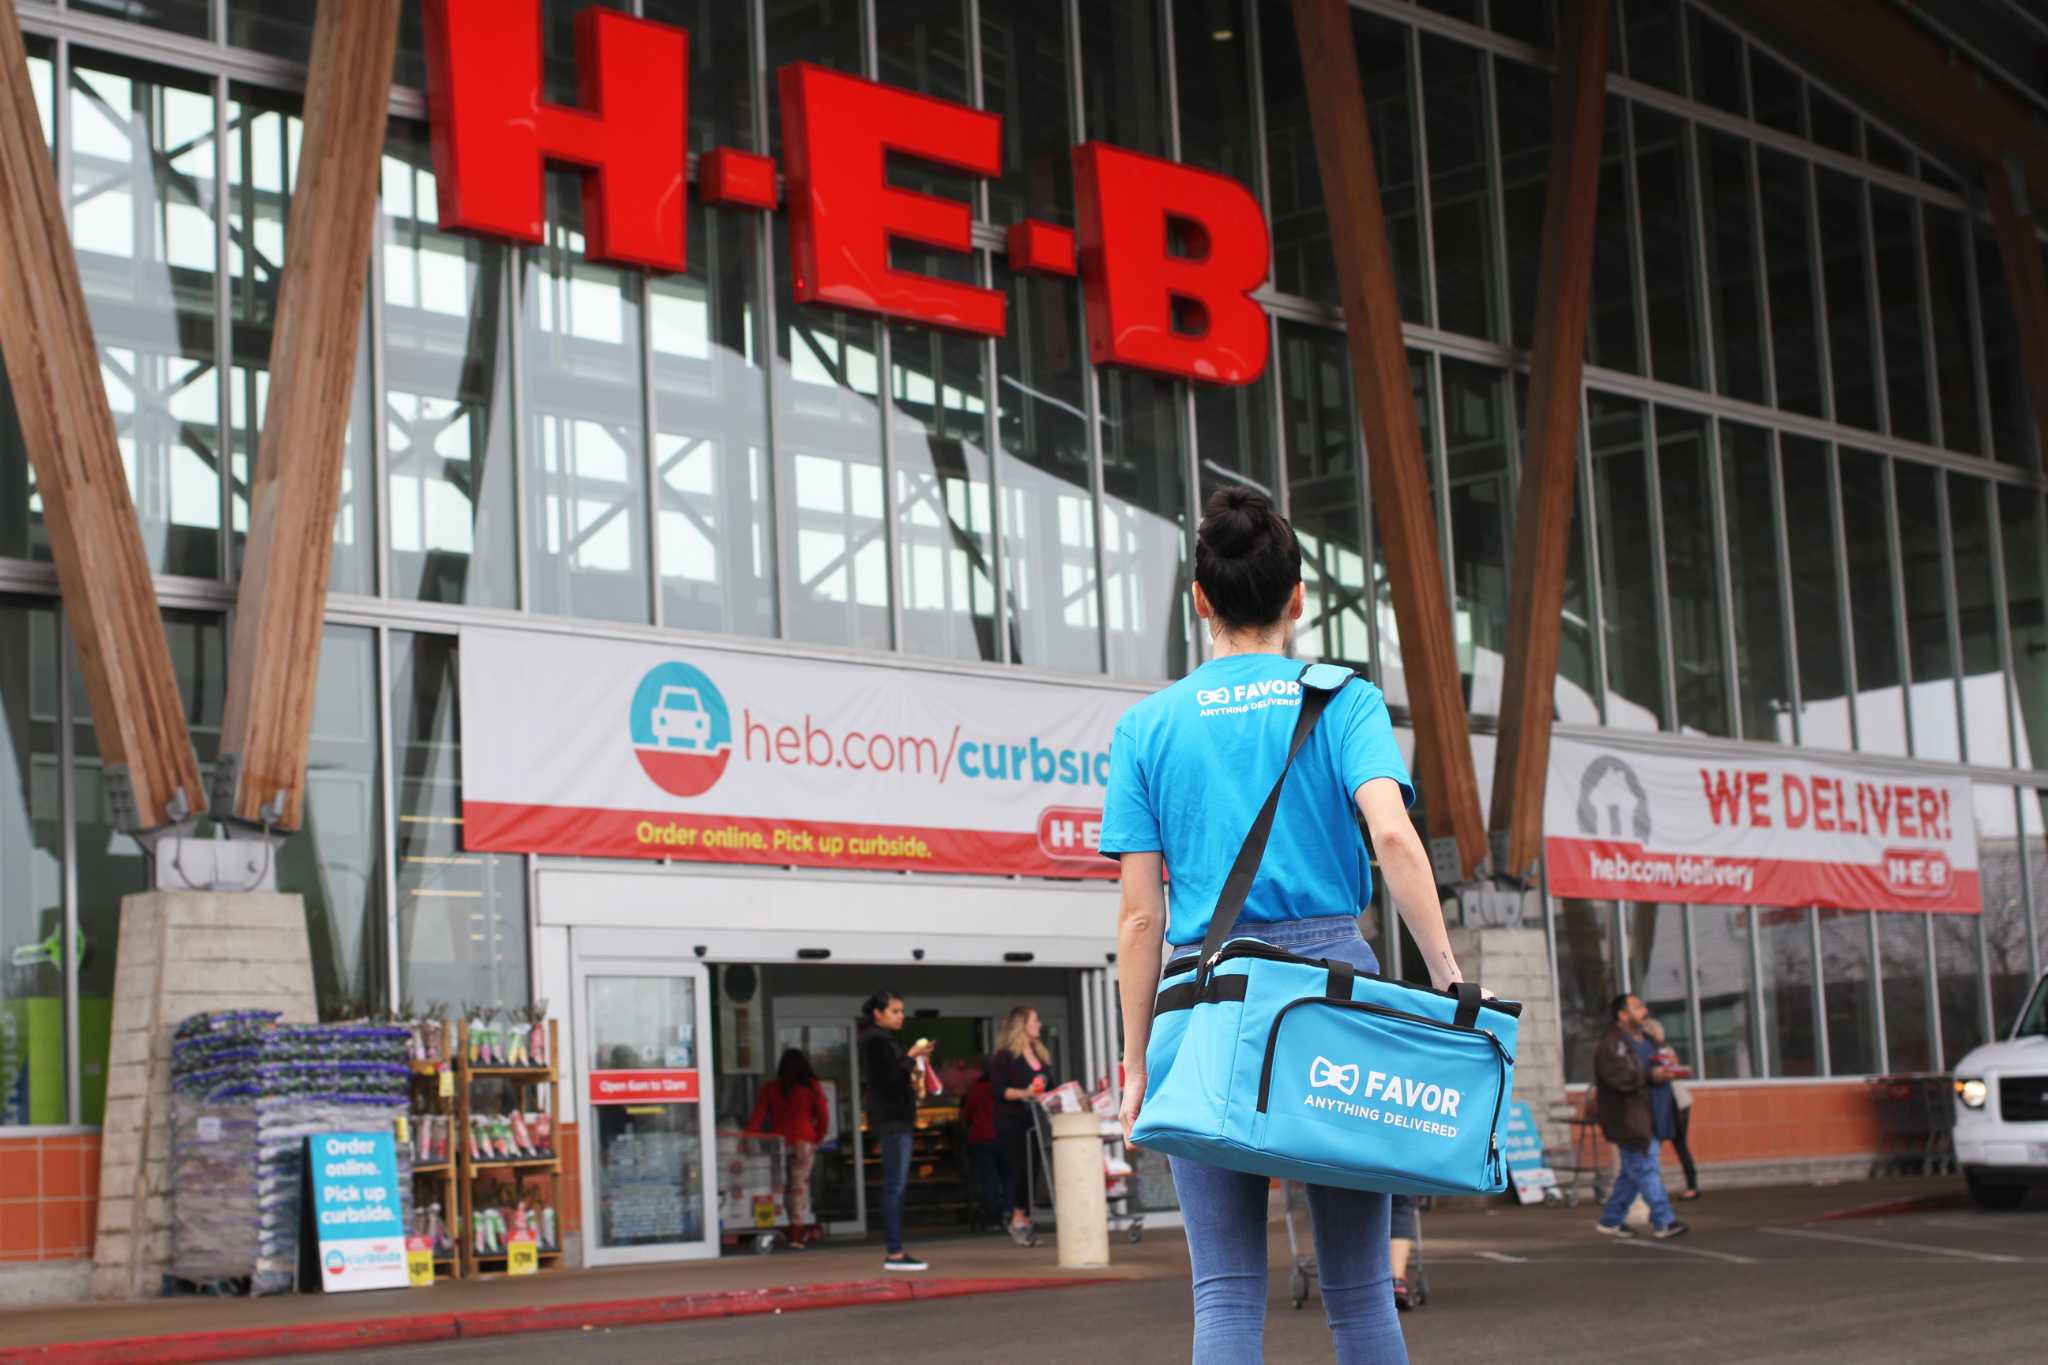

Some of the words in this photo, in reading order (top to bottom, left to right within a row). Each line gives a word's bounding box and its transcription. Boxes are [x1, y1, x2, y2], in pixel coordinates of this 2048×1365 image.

[424, 0, 1273, 387] H-E-B
[1233, 679, 1300, 702] FAVOR
[1200, 705, 1249, 717] ANYTHING
[1250, 697, 1301, 711] DELIVERED
[1700, 768, 1771, 829] WE
[1782, 773, 1952, 840] DELIVER!
[636, 820, 698, 845] Order
[702, 826, 768, 850] online.
[773, 828, 813, 852] Pick
[819, 835, 843, 856] up
[849, 835, 932, 858] curbside.
[1888, 858, 1945, 886] H-E-B
[1364, 1070, 1461, 1118] FAVOR
[1304, 1094, 1379, 1121] ANYTHING
[1383, 1112, 1458, 1138] DELIVERED
[326, 1138, 375, 1156] Order
[325, 1160, 381, 1177] online.
[324, 1186, 360, 1203] Pick
[364, 1186, 386, 1205] up
[321, 1206, 396, 1225] curbside.
